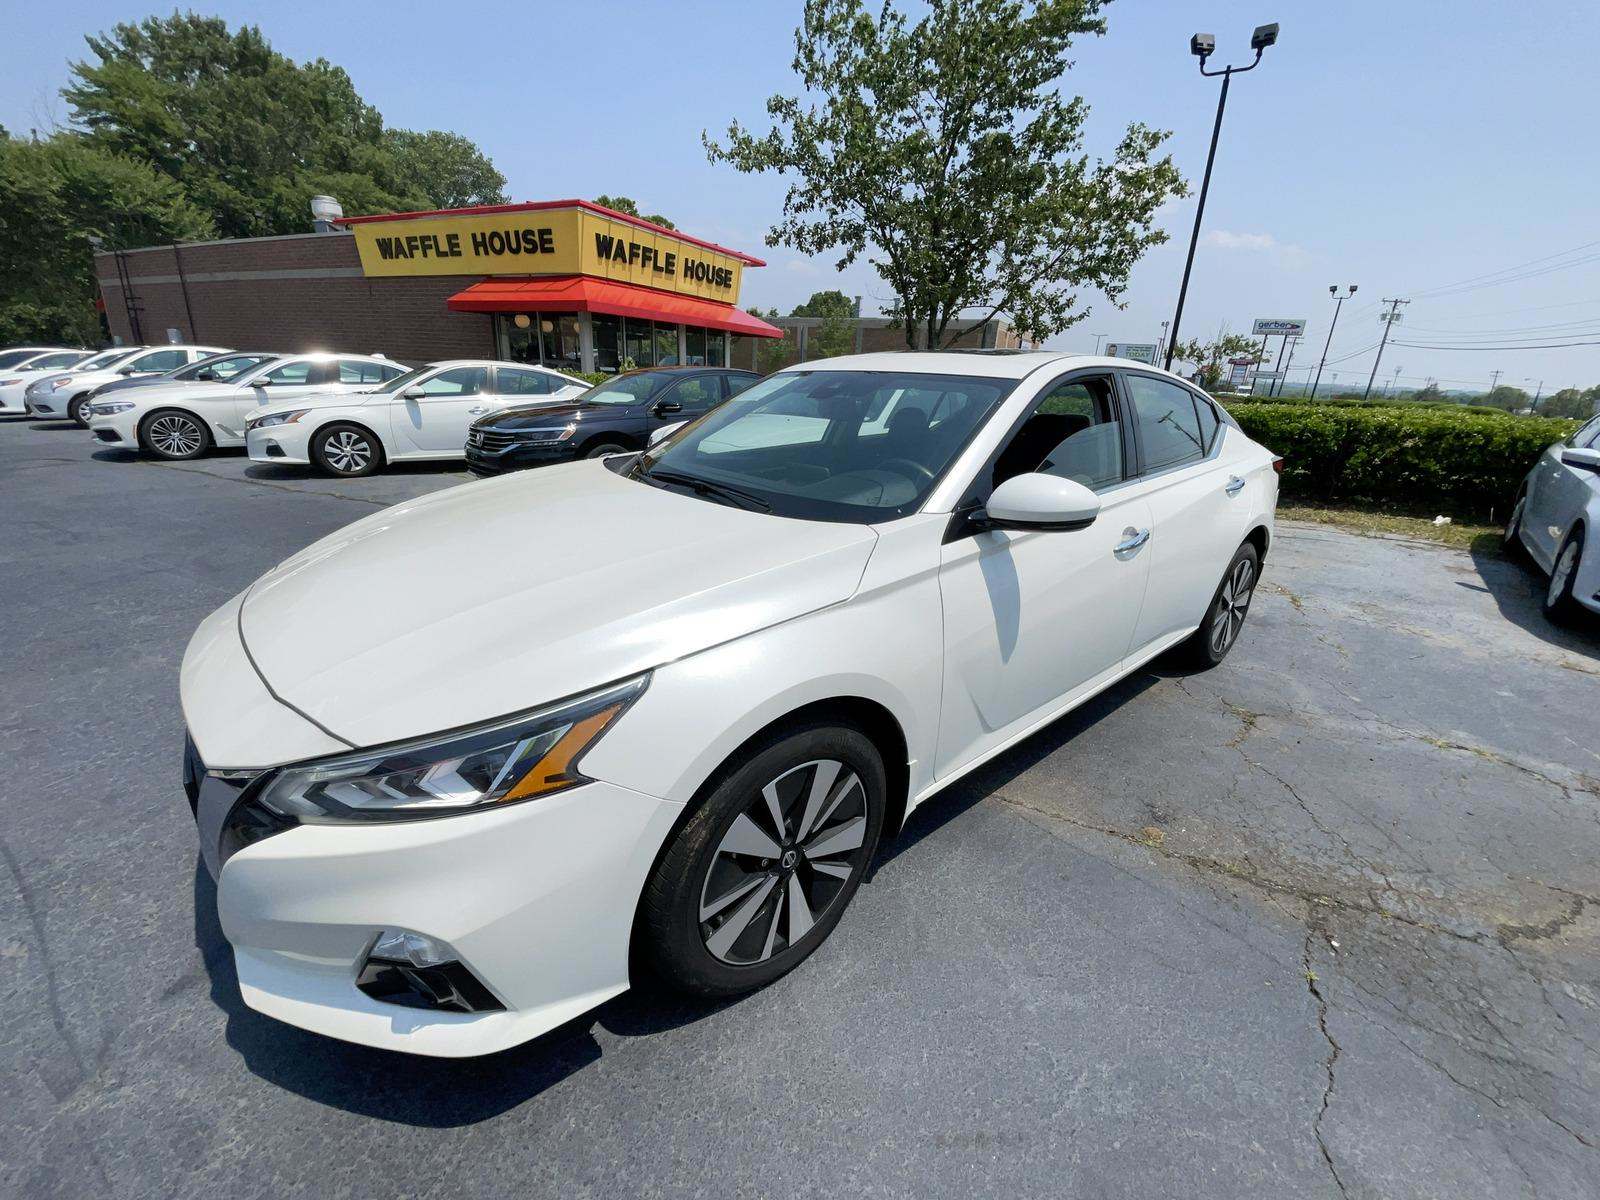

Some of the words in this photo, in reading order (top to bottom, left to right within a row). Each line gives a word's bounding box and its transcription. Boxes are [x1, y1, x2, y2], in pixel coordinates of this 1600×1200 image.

[375, 233, 462, 259] WAFFLE
[471, 228, 555, 256] HOUSE
[595, 232, 676, 275] WAFFLE
[683, 257, 733, 288] HOUSE
[1258, 321, 1290, 330] gerber
